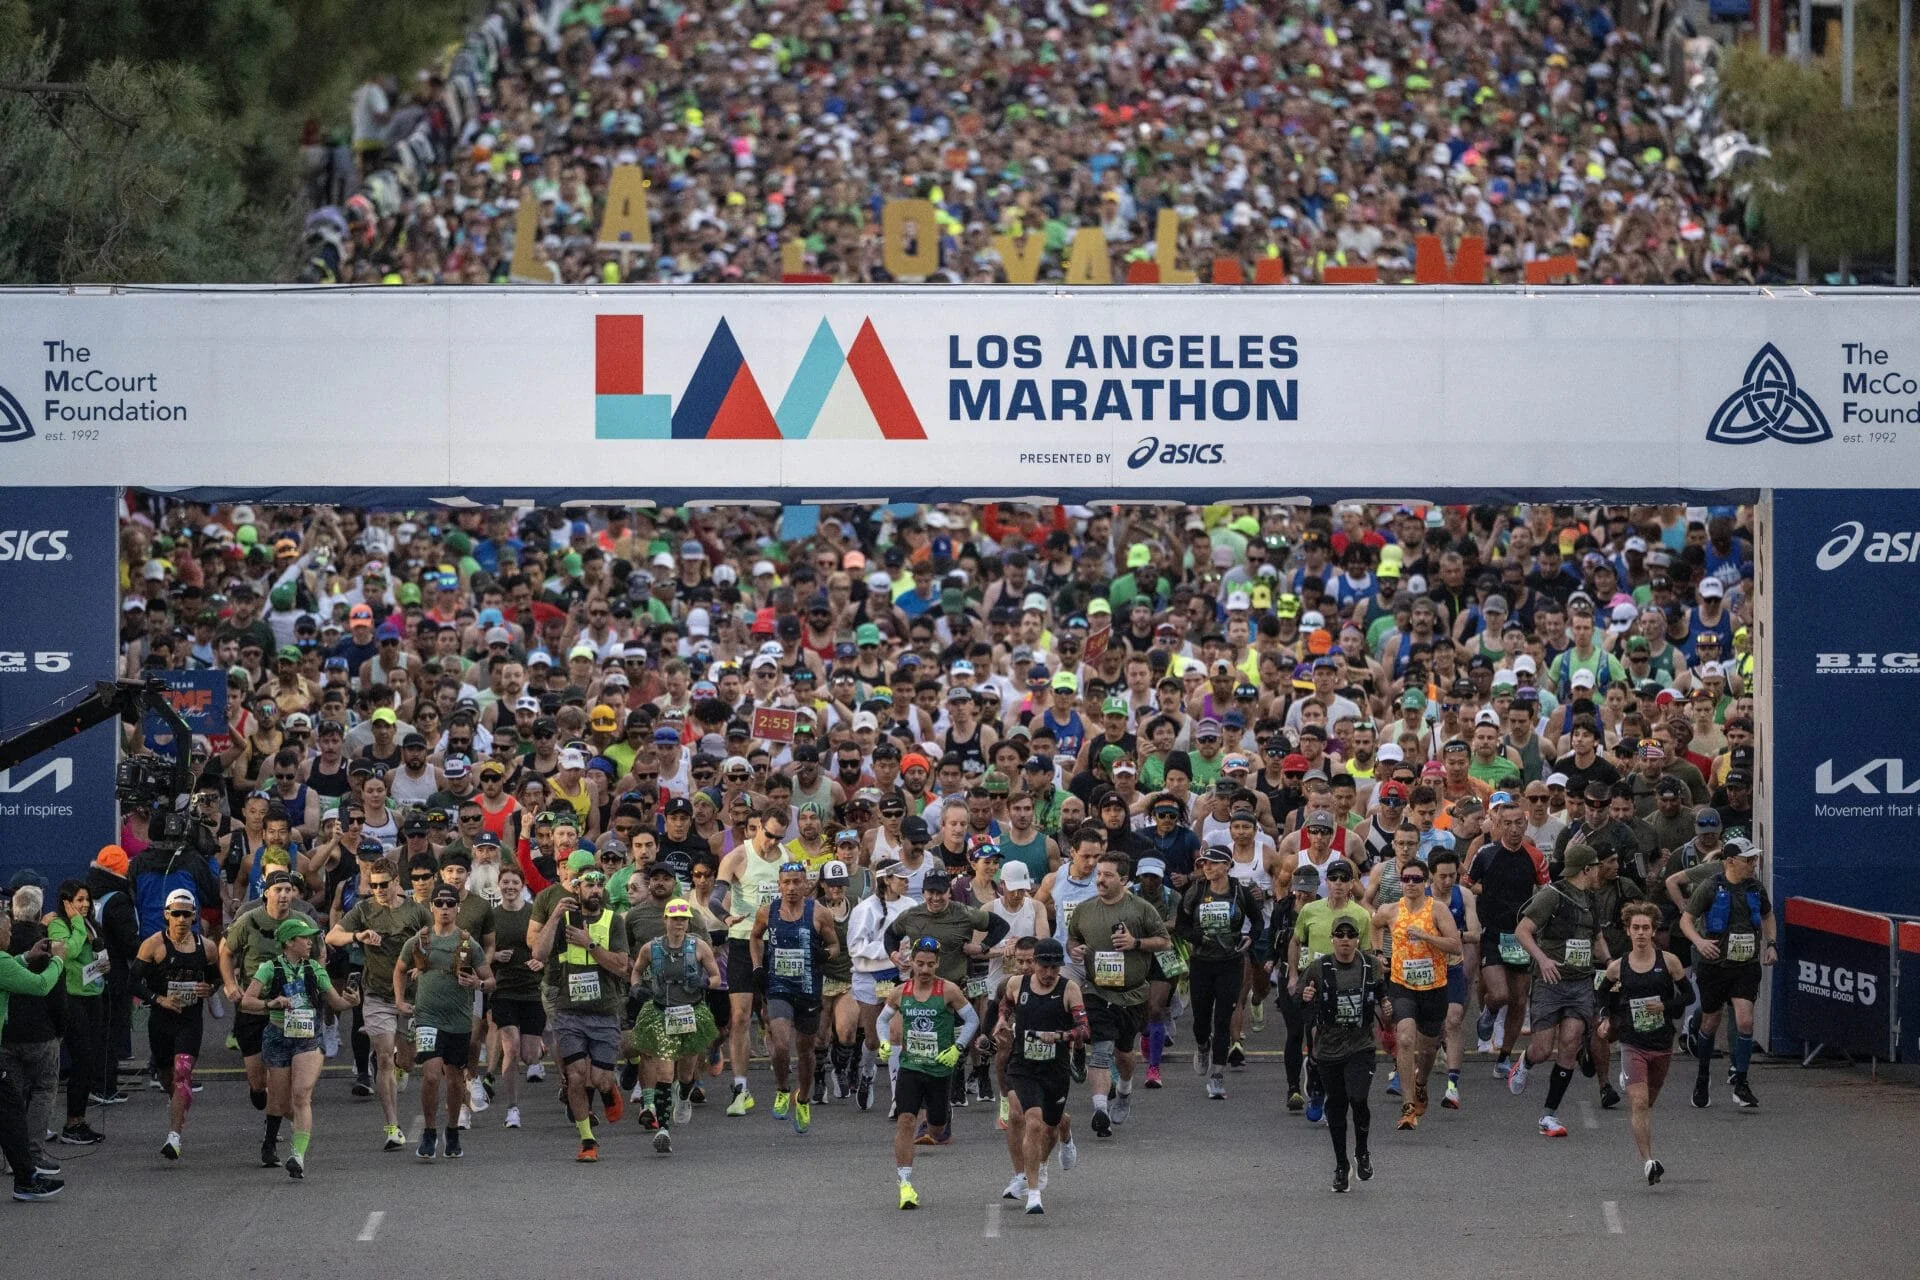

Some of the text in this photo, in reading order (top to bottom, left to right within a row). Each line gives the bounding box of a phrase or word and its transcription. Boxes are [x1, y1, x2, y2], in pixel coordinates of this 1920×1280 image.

[43, 340, 90, 363] The
[950, 335, 1297, 368] LOS ANGELES
[1842, 342, 1888, 365] The
[45, 370, 157, 393] McCourt
[950, 379, 1297, 421] MARATHON
[45, 398, 187, 422] Foundation
[45, 430, 99, 441] est. 1992
[1843, 432, 1897, 443] est. 1992
[1020, 453, 1111, 464] PRESENTED BY
[35, 652, 71, 673] 5
[1816, 653, 1920, 668] BIG
[759, 715, 790, 730] 2:55
[24, 803, 73, 819] inspires
[1815, 804, 1913, 817] Movement that
[1798, 960, 1877, 1006] BIG 5
[905, 1007, 938, 1017] MÉXICO
